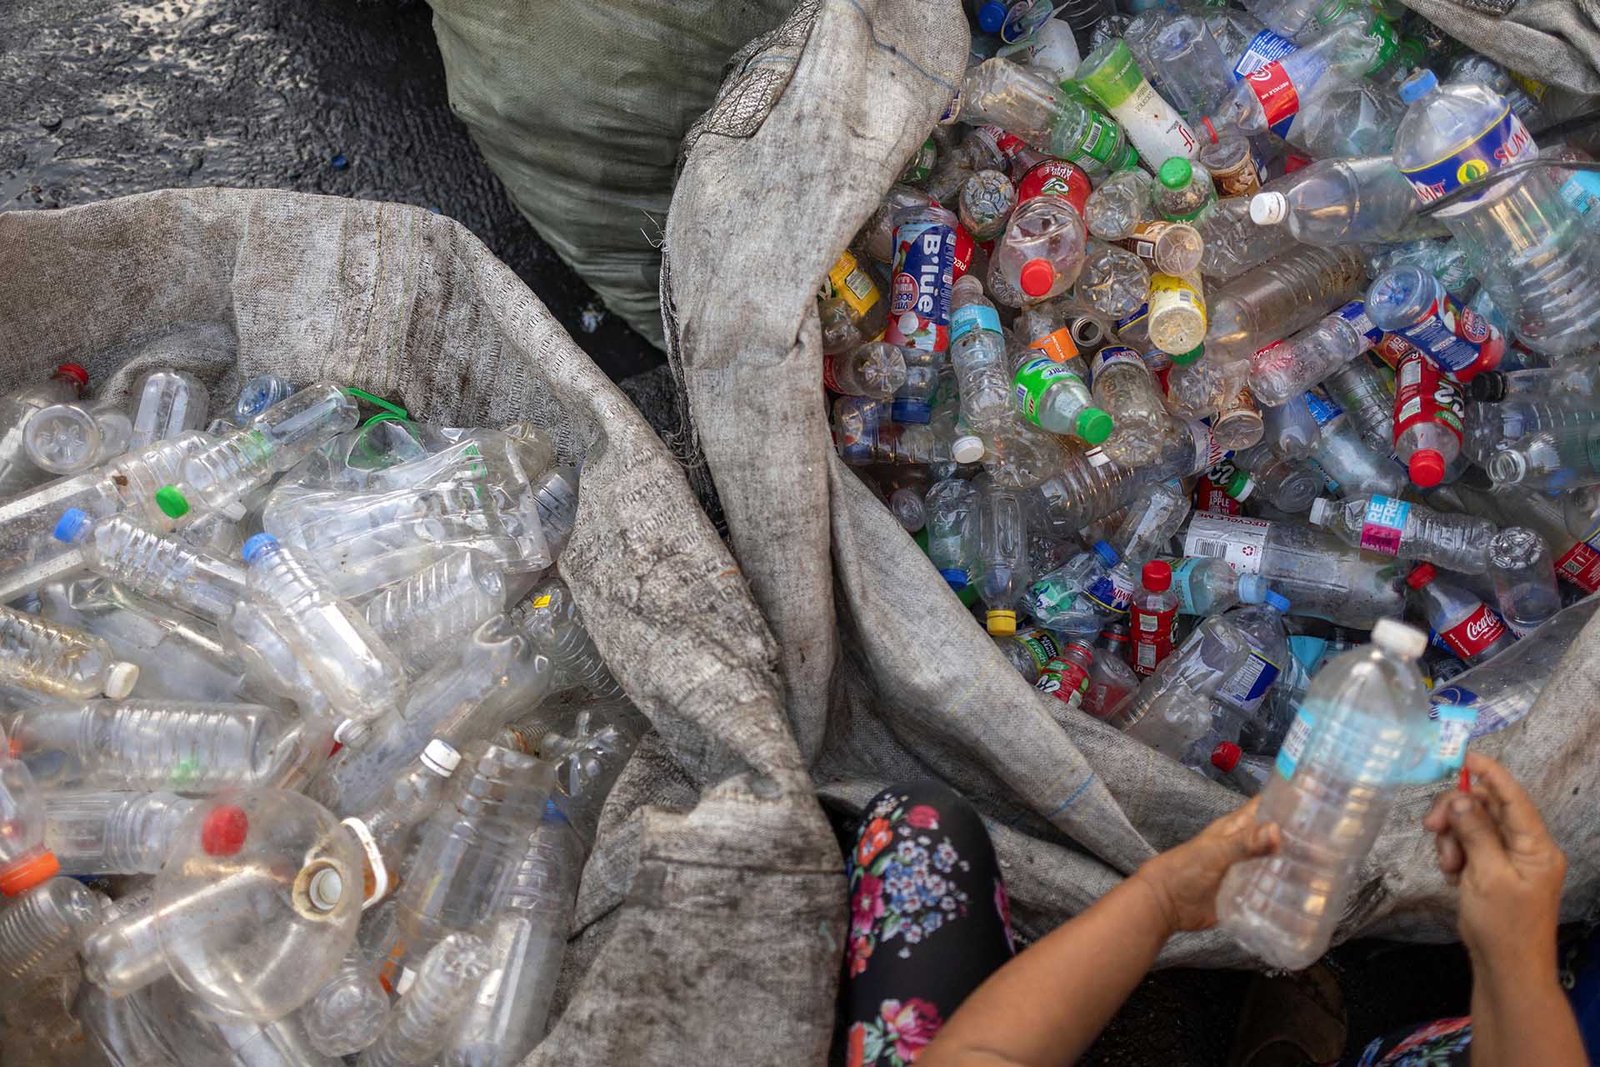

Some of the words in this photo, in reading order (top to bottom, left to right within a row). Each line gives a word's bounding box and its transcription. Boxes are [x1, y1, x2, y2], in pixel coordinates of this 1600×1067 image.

[1044, 165, 1073, 177] APPLE
[1368, 502, 1384, 522] RE
[1216, 515, 1267, 527] RECYCLE
